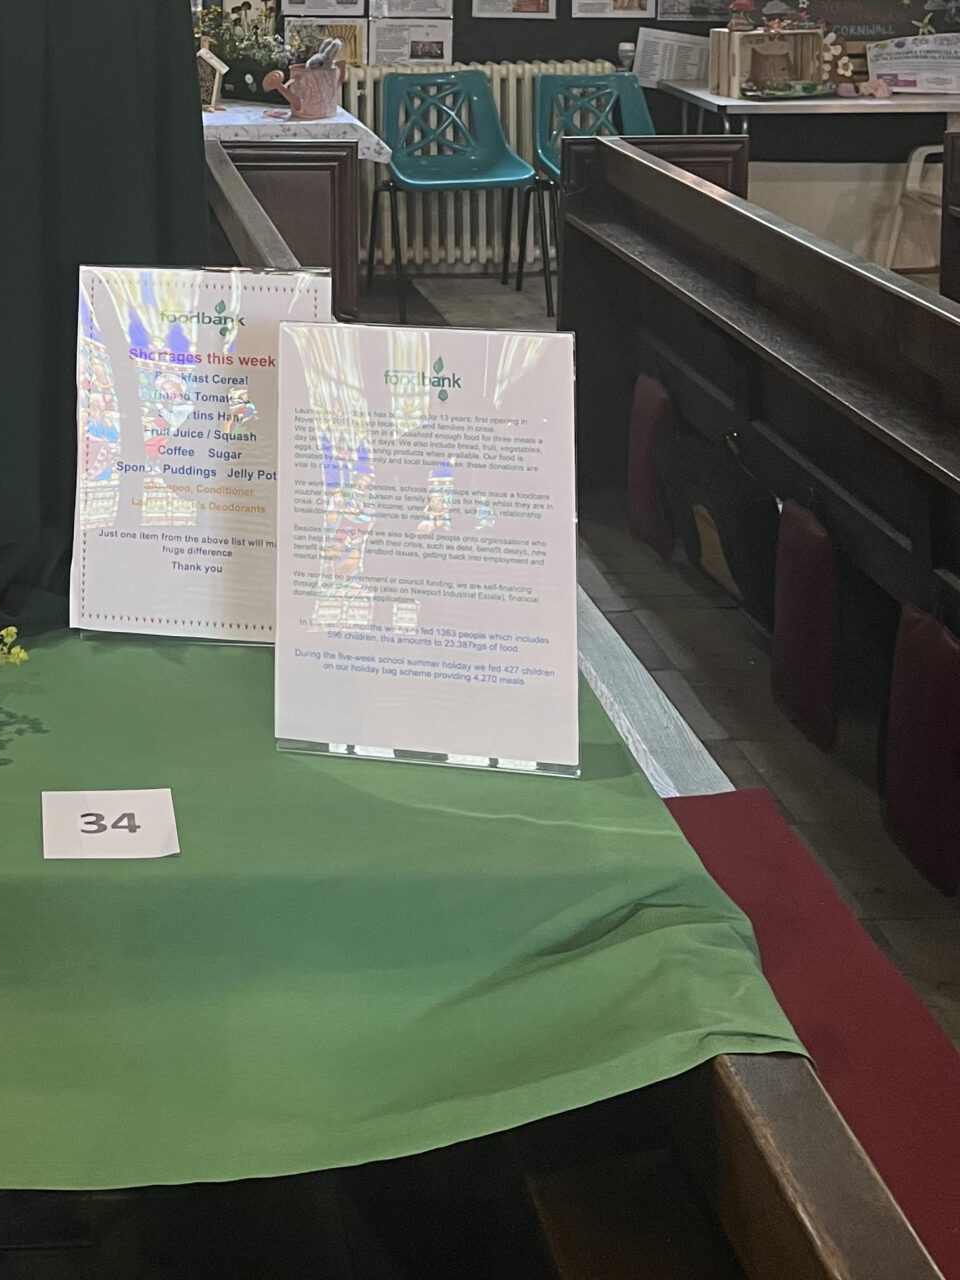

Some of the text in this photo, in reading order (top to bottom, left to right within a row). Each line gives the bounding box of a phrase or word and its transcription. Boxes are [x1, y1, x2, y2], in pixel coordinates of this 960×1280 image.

[832, 24, 895, 36] CORNWALL
[160, 310, 246, 326] foodbank
[129, 348, 277, 367] Shortages this week
[155, 372, 248, 385] Bkfast Cereal
[384, 370, 462, 388] foodbank
[195, 392, 250, 404] Toma
[194, 411, 214, 421] tins
[490, 417, 519, 426] opening
[174, 428, 204, 439] Juice
[207, 429, 211, 439] /
[214, 430, 257, 444] Squash
[294, 434, 307, 442] day
[435, 433, 462, 442] enough
[158, 445, 242, 462] Coffee Sugar
[394, 448, 424, 458] products
[117, 461, 161, 473] Spon
[163, 464, 217, 479] Puddings
[227, 468, 254, 481] Jelly
[144, 481, 255, 497] Spoo, Conditioner
[516, 492, 550, 500] foodbank
[209, 501, 266, 514] Deodorants
[404, 495, 425, 504] family
[474, 499, 490, 507] help
[515, 501, 530, 510] they
[500, 510, 542, 520] relationship
[98, 529, 118, 538] Just
[139, 531, 159, 540] item
[161, 532, 182, 542] from
[185, 534, 199, 543] the
[201, 536, 229, 545] above
[231, 537, 245, 546] list
[248, 538, 263, 547] will
[294, 524, 322, 532] Besides
[436, 533, 461, 543] people
[162, 545, 233, 557] huge difference
[365, 547, 393, 555] landlord
[422, 551, 447, 560] getting
[484, 555, 529, 566] employment
[171, 561, 223, 575] Thank you
[346, 574, 388, 584] government
[413, 588, 442, 598] Newport
[443, 590, 477, 599] Industrial
[508, 595, 539, 603] financial
[381, 634, 395, 643] this
[397, 636, 432, 646] amounts
[421, 627, 433, 635] fed
[458, 630, 486, 641] people
[488, 632, 512, 641] which
[515, 634, 550, 644] includes
[295, 649, 321, 660] During
[323, 651, 336, 659] the
[338, 652, 376, 662] five-week
[378, 655, 405, 665] school
[407, 659, 440, 668] summer
[442, 661, 472, 672] holiday
[488, 664, 502, 672] fed
[504, 665, 519, 674] 427
[521, 667, 555, 677] children
[351, 664, 380, 675] holiday
[382, 666, 397, 677] bag
[399, 668, 432, 678] scheme
[434, 670, 472, 682] providing
[499, 675, 525, 685] meals
[80, 812, 142, 834] 34
